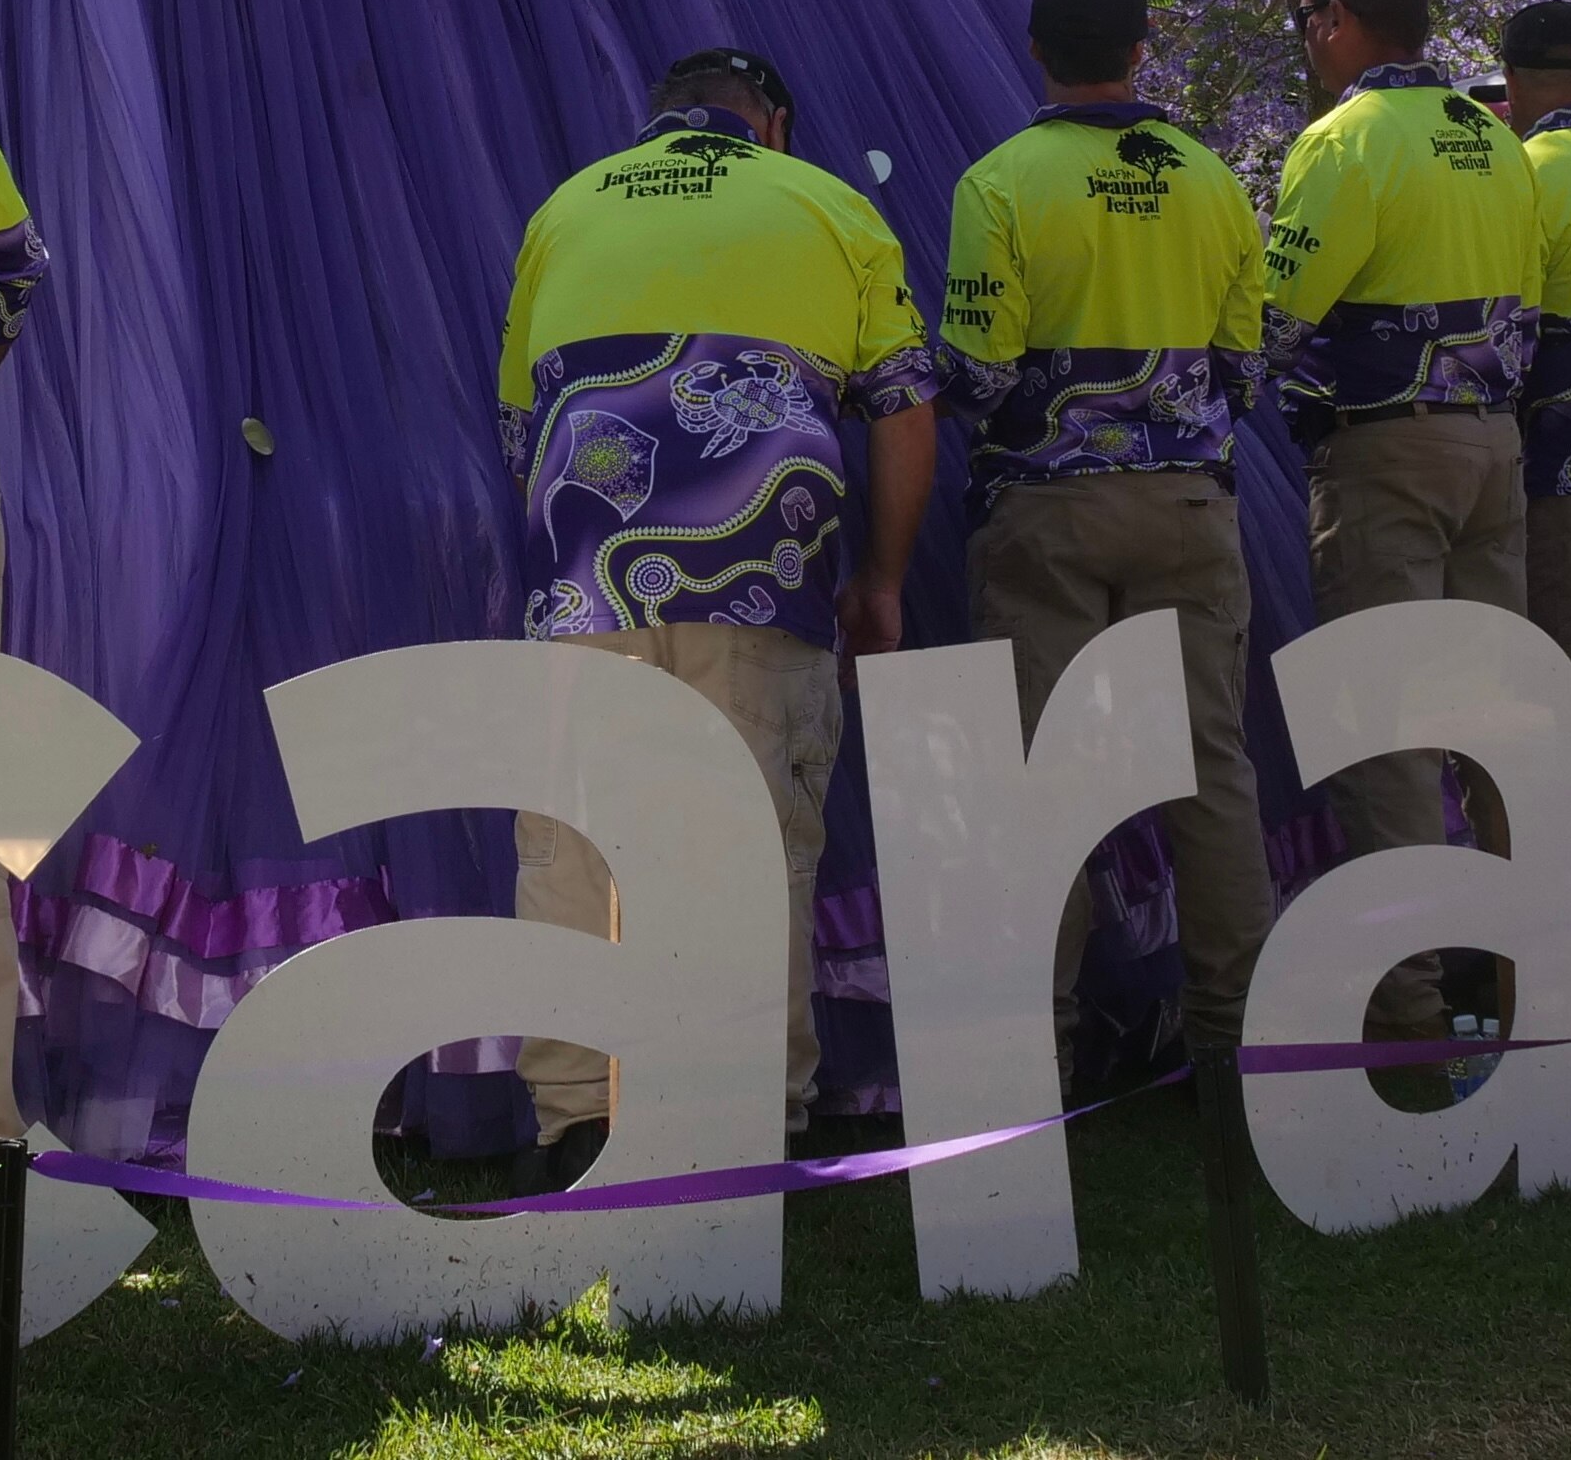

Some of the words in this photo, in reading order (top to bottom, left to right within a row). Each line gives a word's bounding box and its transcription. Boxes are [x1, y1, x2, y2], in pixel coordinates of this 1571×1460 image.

[1430, 137, 1494, 157] Jacaranda
[621, 158, 688, 173] GRAFTON
[1449, 153, 1491, 170] Festival
[596, 165, 728, 192] Jacaranda
[625, 177, 713, 199] Festival
[1269, 222, 1320, 254] urple
[1262, 249, 1303, 281] rmy
